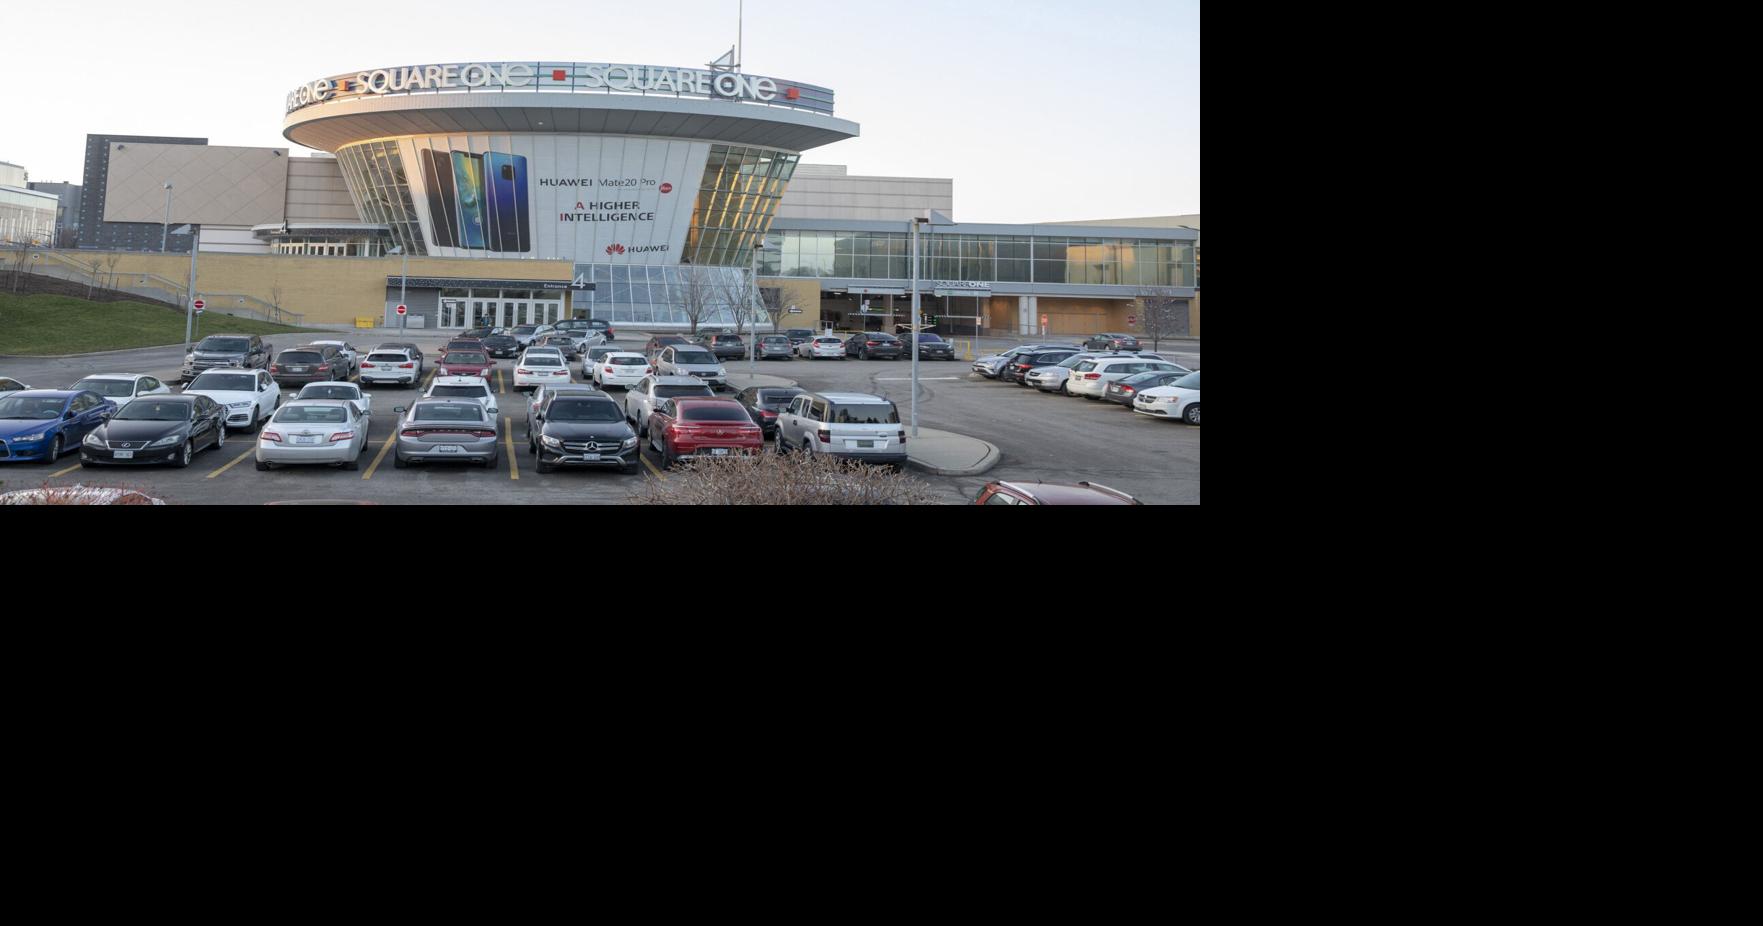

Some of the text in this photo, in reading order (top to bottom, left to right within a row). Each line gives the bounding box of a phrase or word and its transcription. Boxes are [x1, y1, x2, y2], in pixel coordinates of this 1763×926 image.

[356, 64, 459, 94] SQUARE
[585, 64, 711, 92] SQUARE
[539, 178, 593, 187] HUAWEI
[640, 178, 656, 186] Pro
[575, 201, 641, 210] A HIGHER
[560, 212, 655, 222] INTELLIGENCE
[627, 245, 669, 253] HUAWEI
[571, 272, 586, 288] 4
